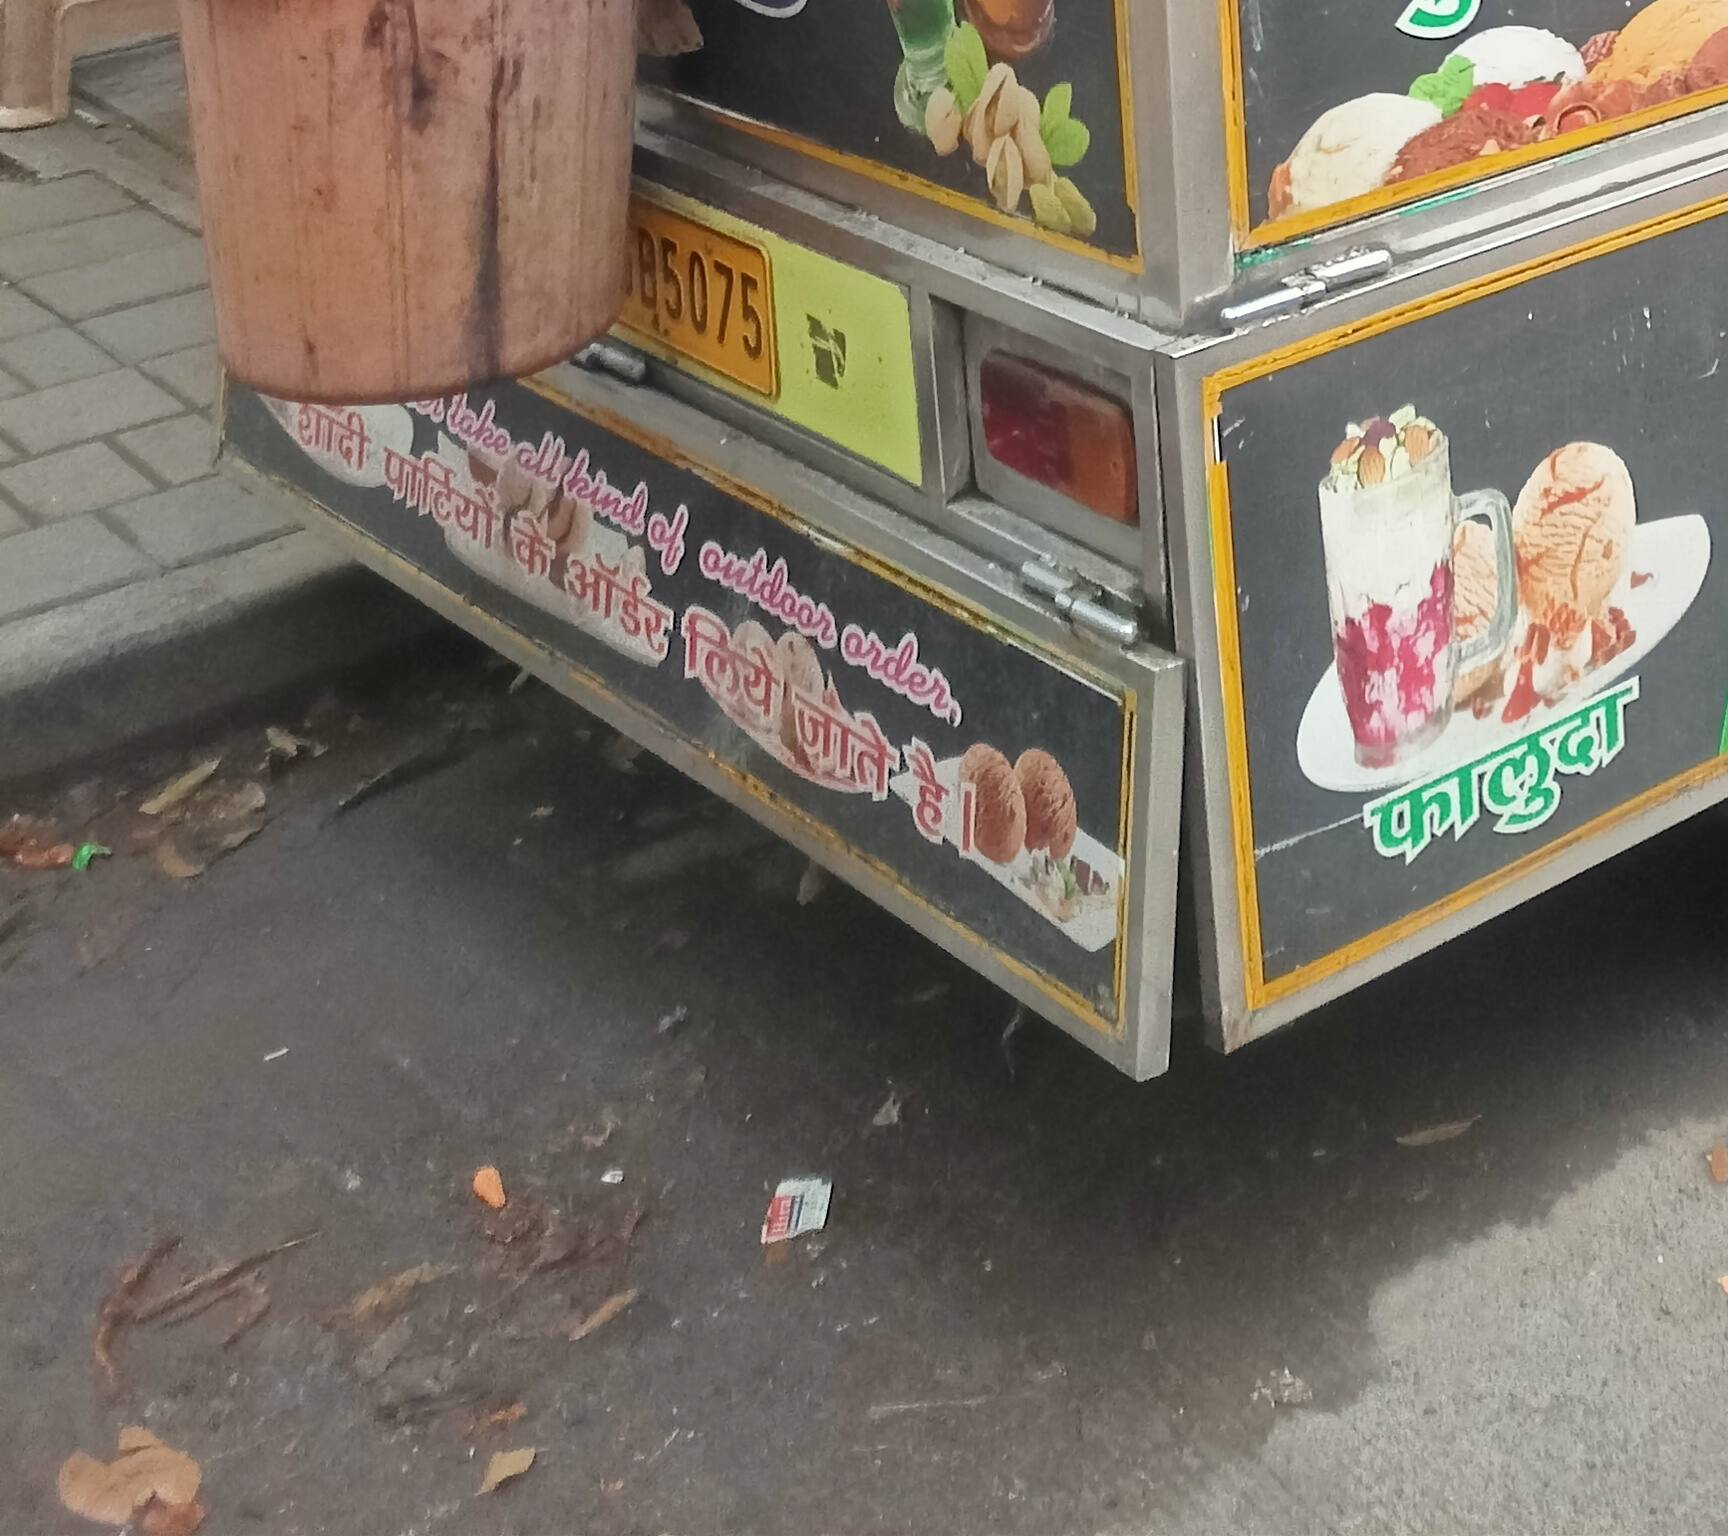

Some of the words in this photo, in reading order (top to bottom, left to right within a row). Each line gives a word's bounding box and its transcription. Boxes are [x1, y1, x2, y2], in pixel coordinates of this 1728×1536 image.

[298, 403, 370, 472] शादी
[512, 511, 556, 578] के
[562, 552, 673, 656] ऑर्डर
[684, 606, 782, 720] लिये
[790, 711, 900, 798] जाते
[446, 392, 511, 456] take
[518, 431, 565, 485] all
[564, 449, 649, 536] kind
[649, 504, 690, 576] of
[699, 540, 838, 650] outdoor
[1363, 676, 1640, 865] फालुदा
